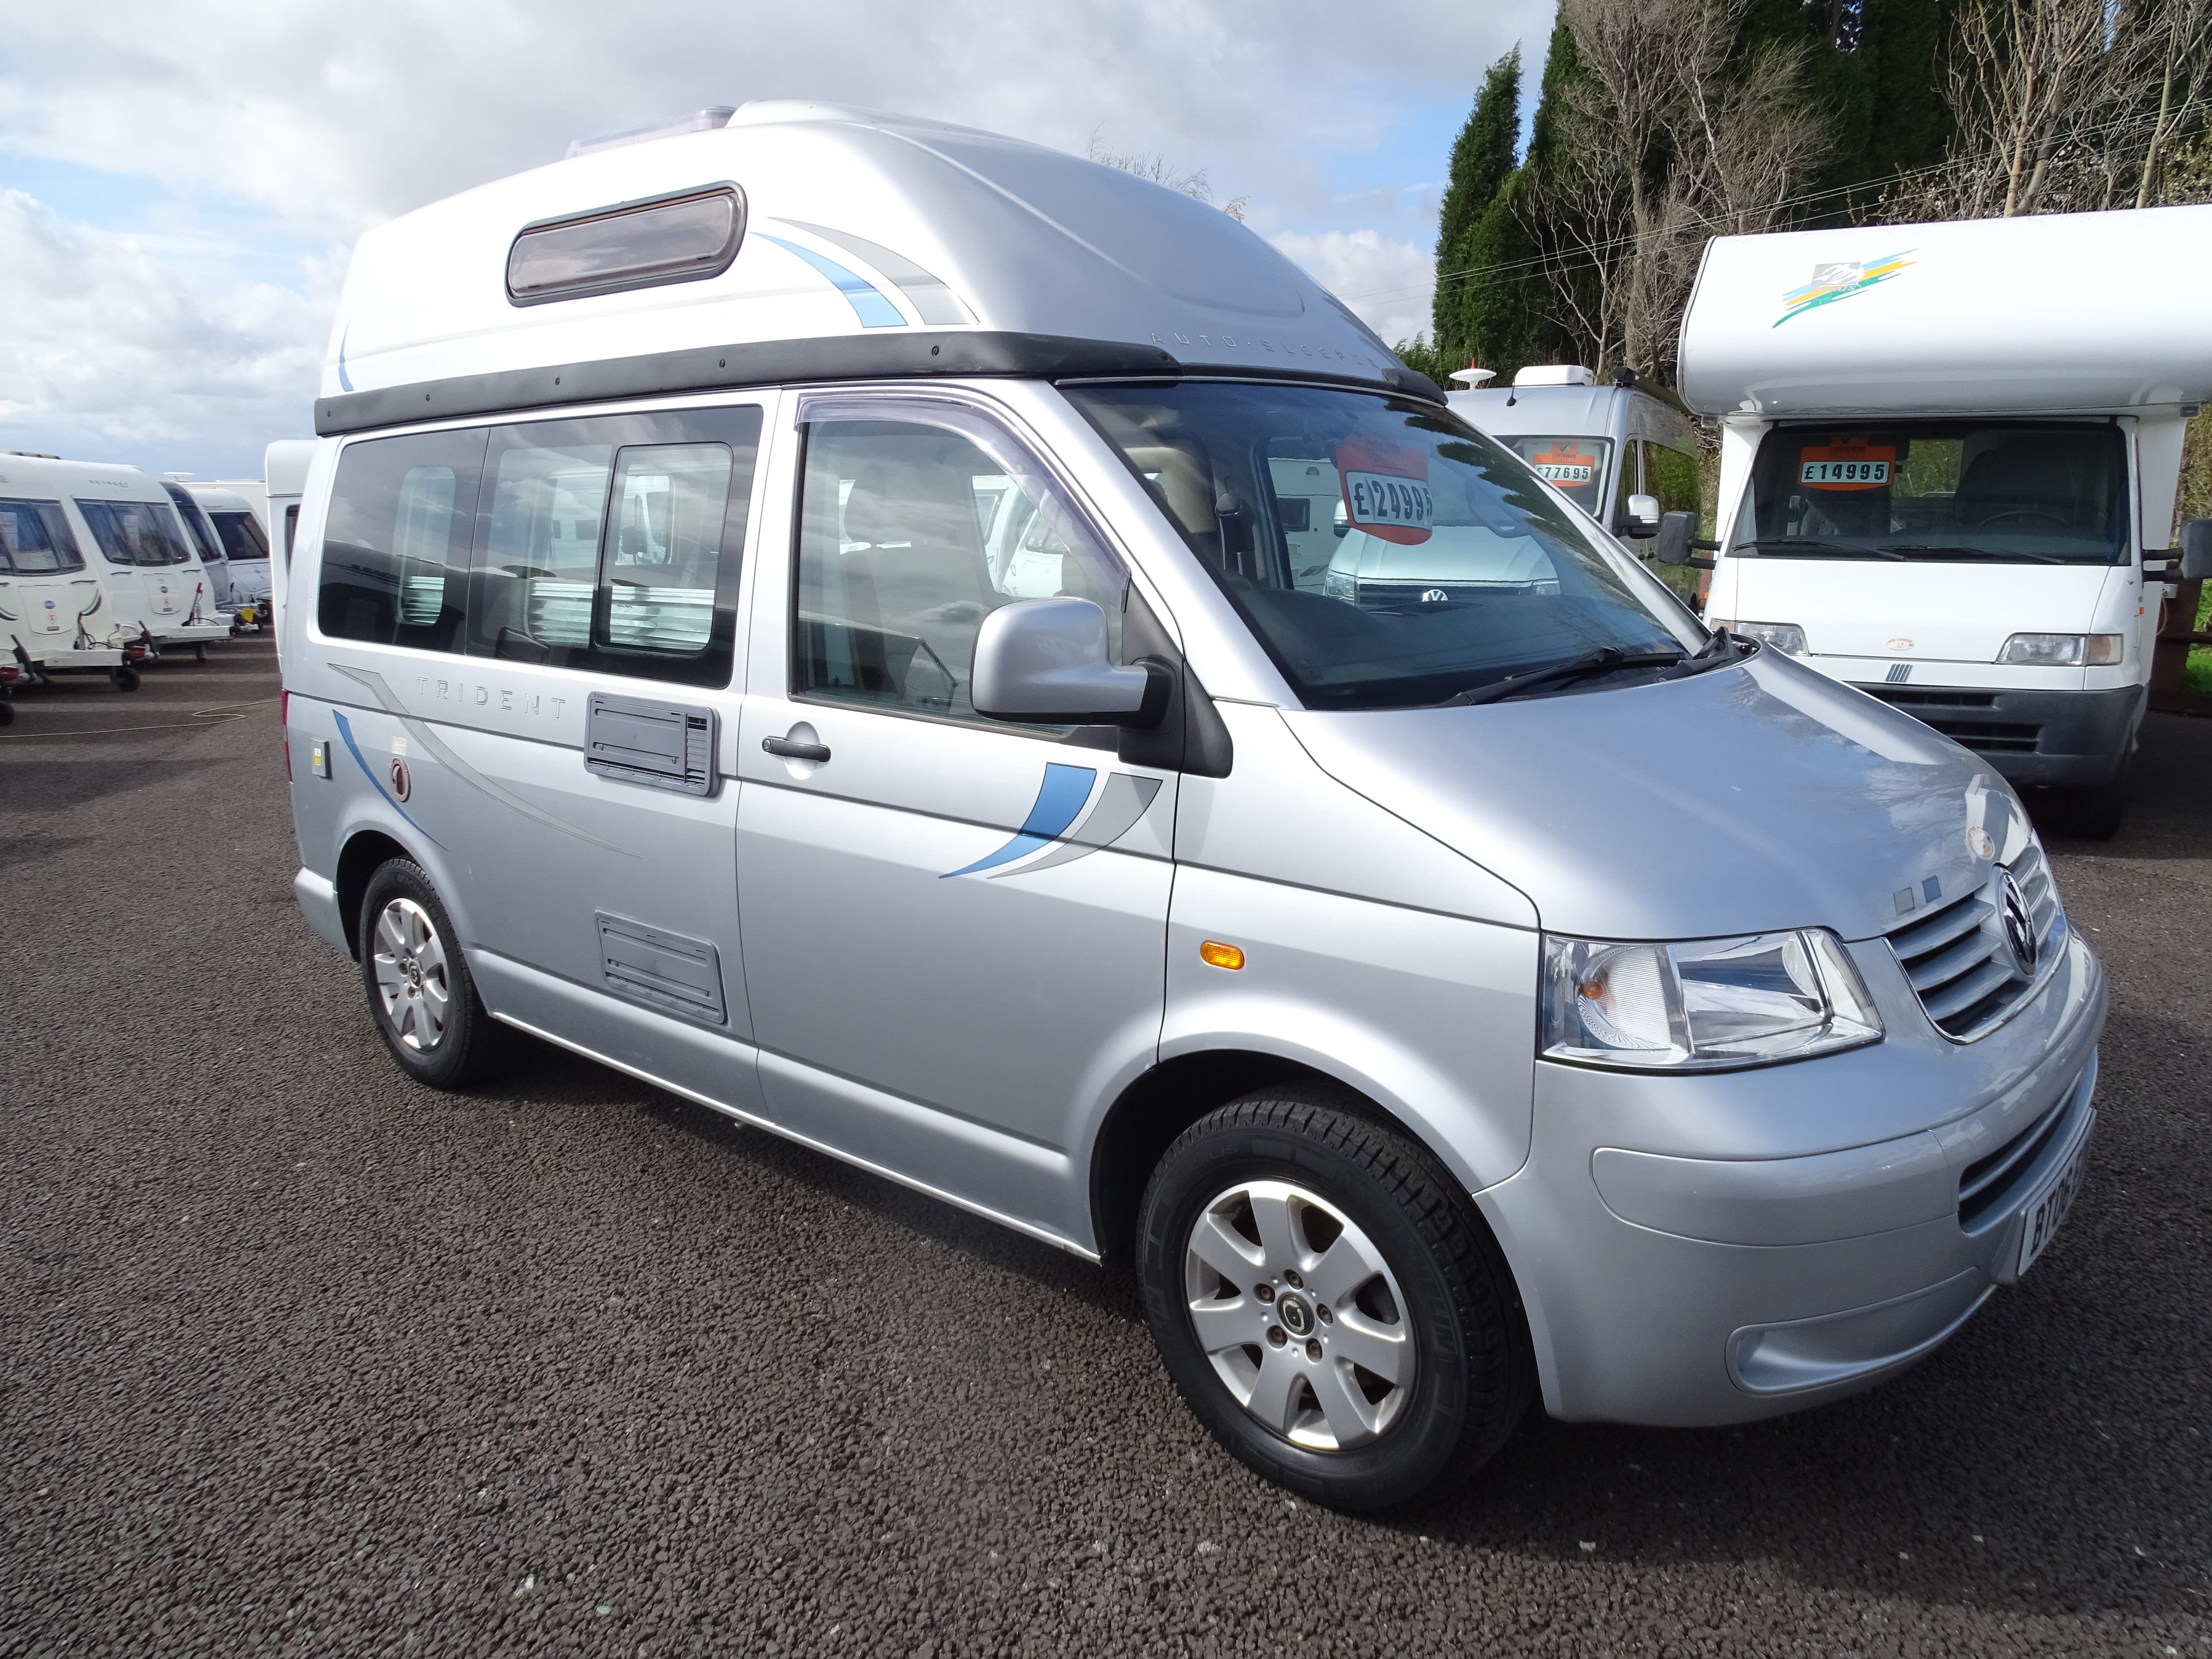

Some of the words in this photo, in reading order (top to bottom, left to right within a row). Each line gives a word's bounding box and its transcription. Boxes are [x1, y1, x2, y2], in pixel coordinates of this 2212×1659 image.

[1804, 463, 1885, 480] £14995
[1353, 479, 1433, 521] £24995
[416, 675, 566, 719] TRIDENT
